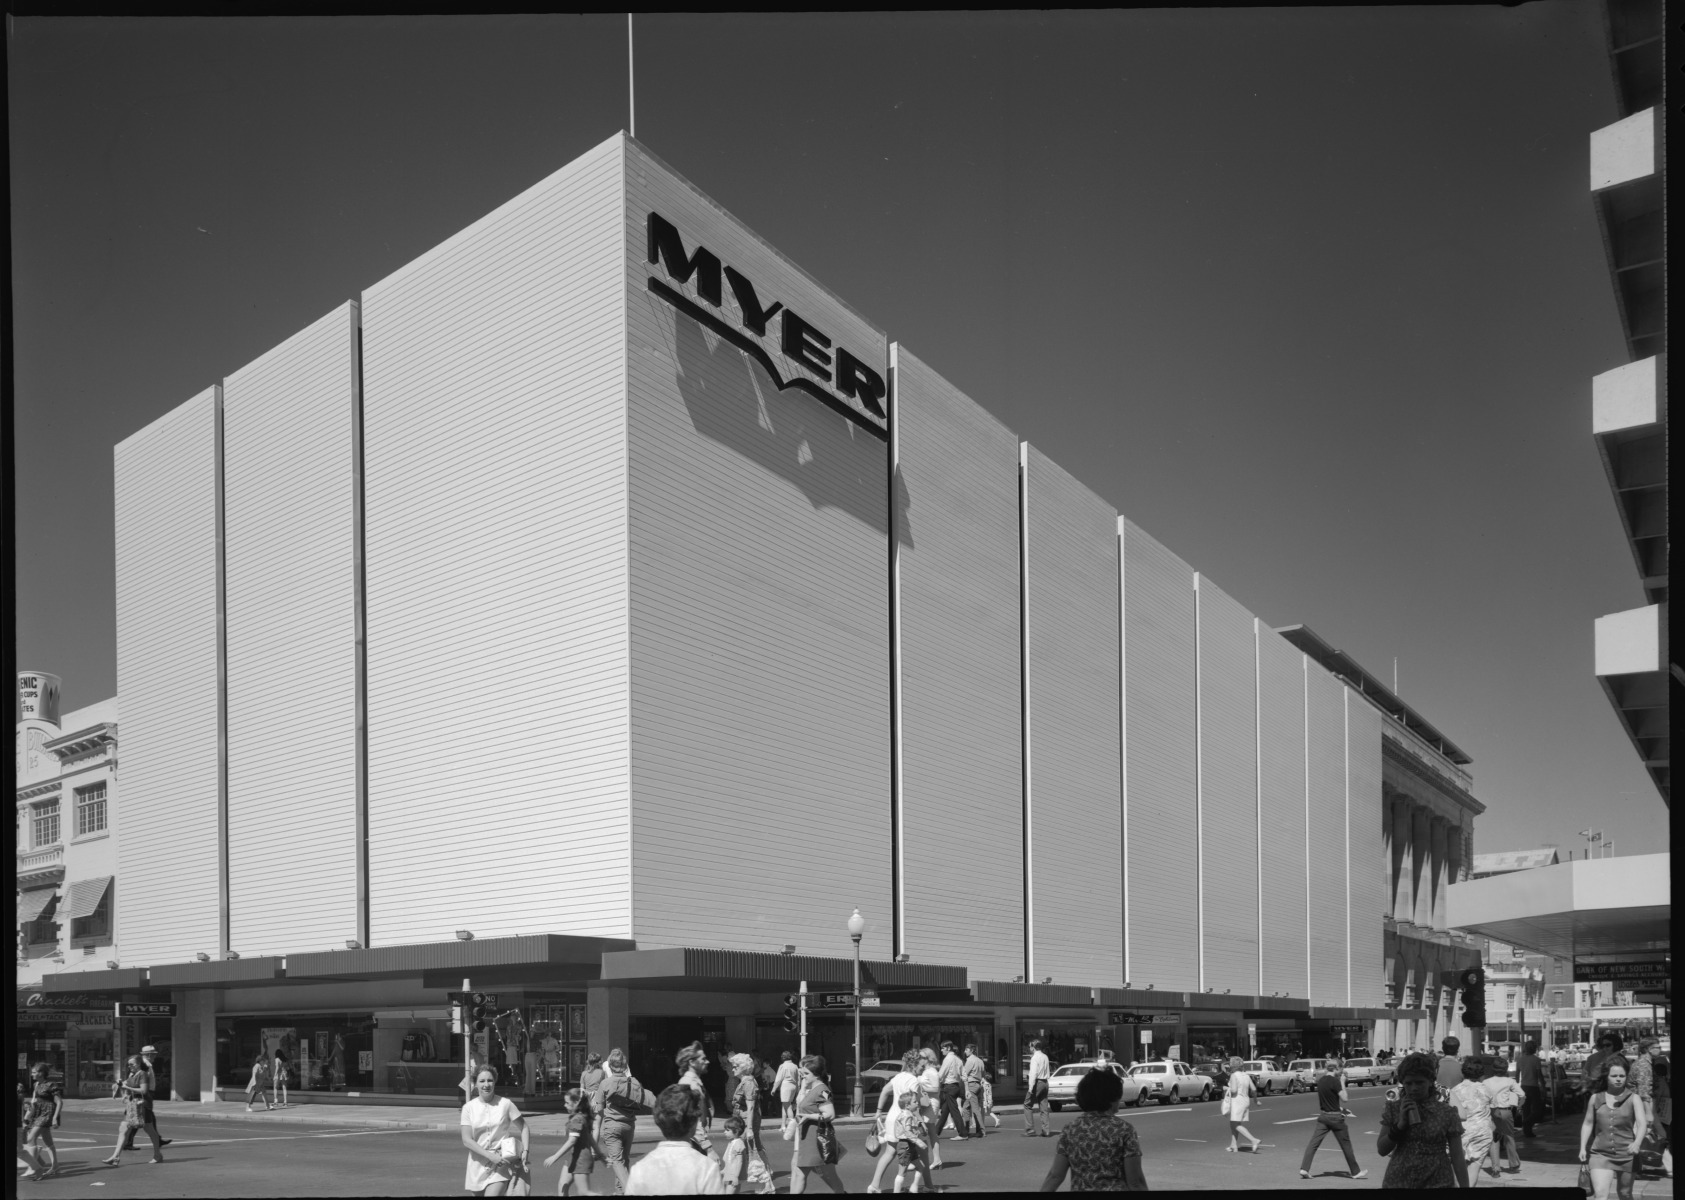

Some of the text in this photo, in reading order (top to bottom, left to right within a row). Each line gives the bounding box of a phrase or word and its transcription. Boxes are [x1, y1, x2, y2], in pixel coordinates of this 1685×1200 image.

[647, 211, 887, 419] MYER
[1576, 966, 1595, 974] BANK
[1629, 964, 1653, 972] SOUTH
